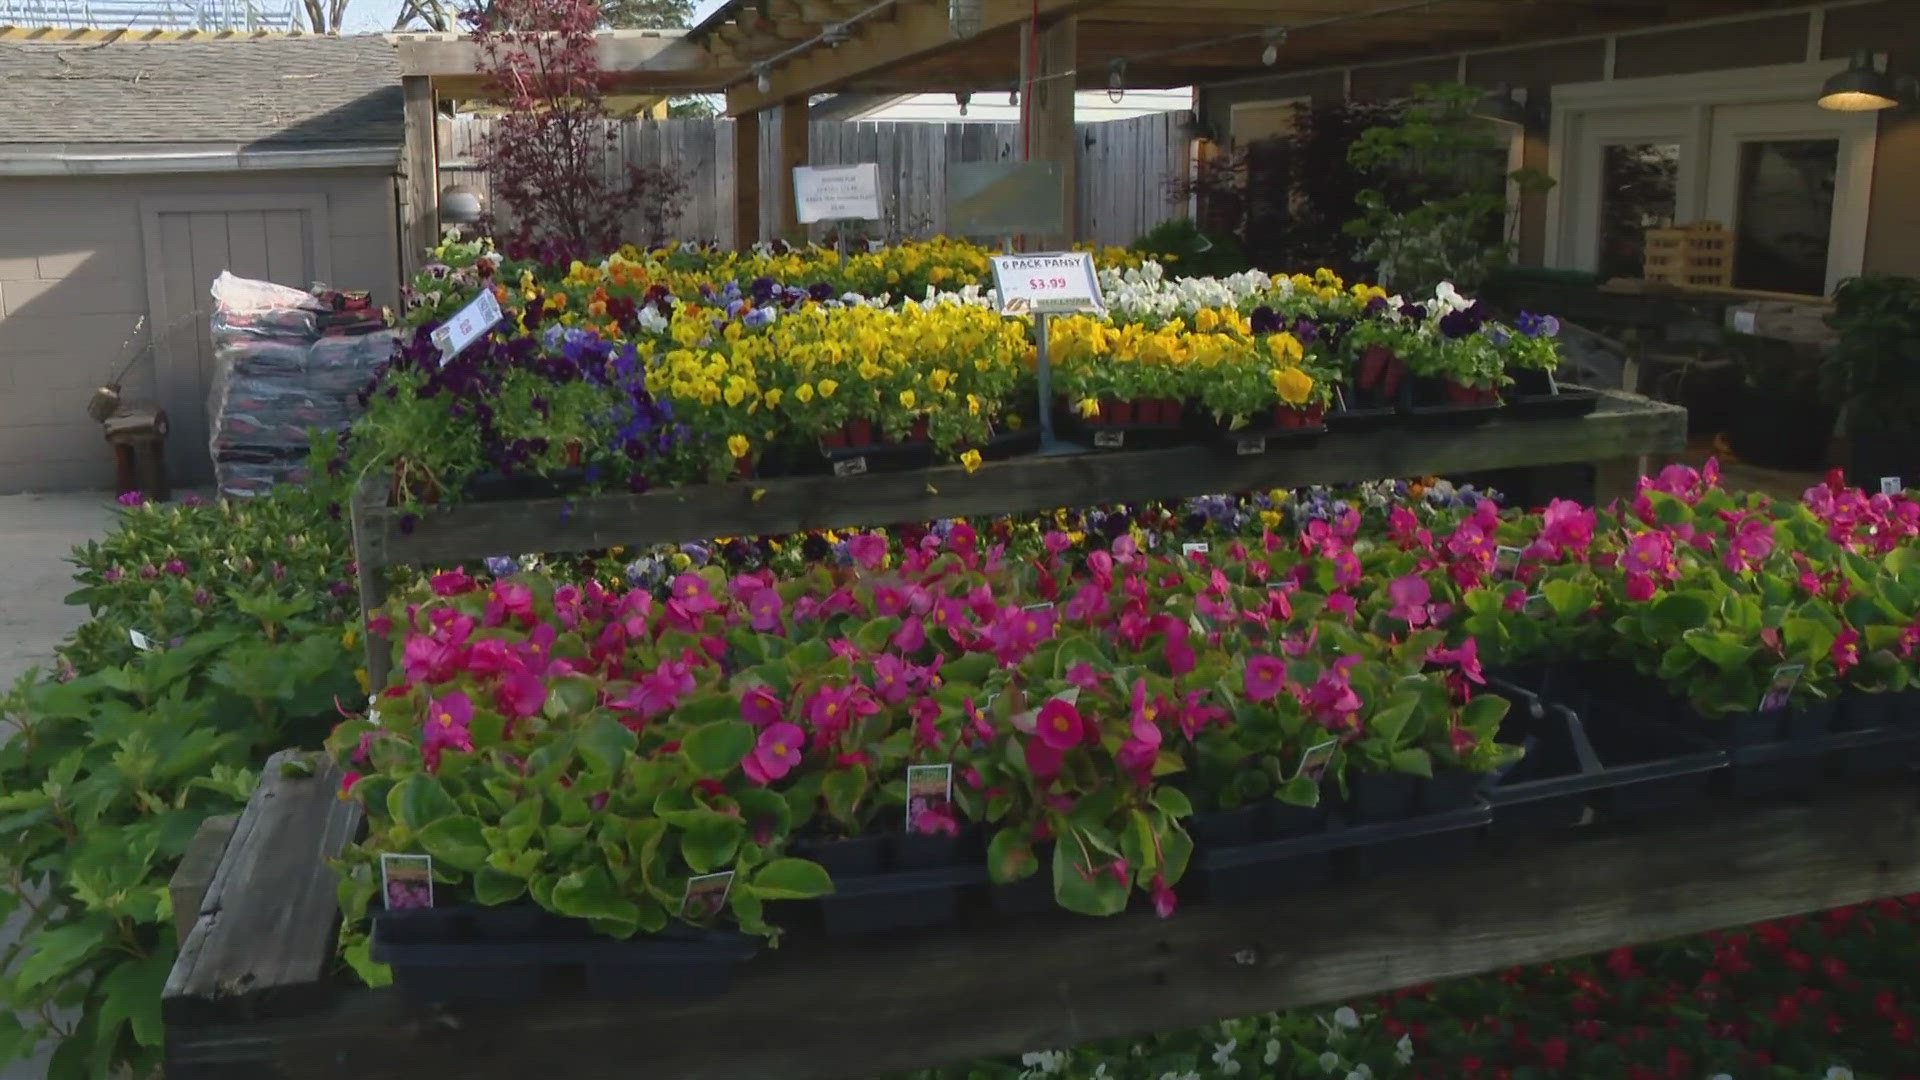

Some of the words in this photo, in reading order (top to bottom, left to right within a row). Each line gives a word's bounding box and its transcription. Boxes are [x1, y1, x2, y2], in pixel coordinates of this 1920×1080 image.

[1002, 261, 1009, 270] 6
[1012, 259, 1042, 269] PACK
[1045, 259, 1081, 268] PANSY
[1029, 278, 1067, 290] $3.99
